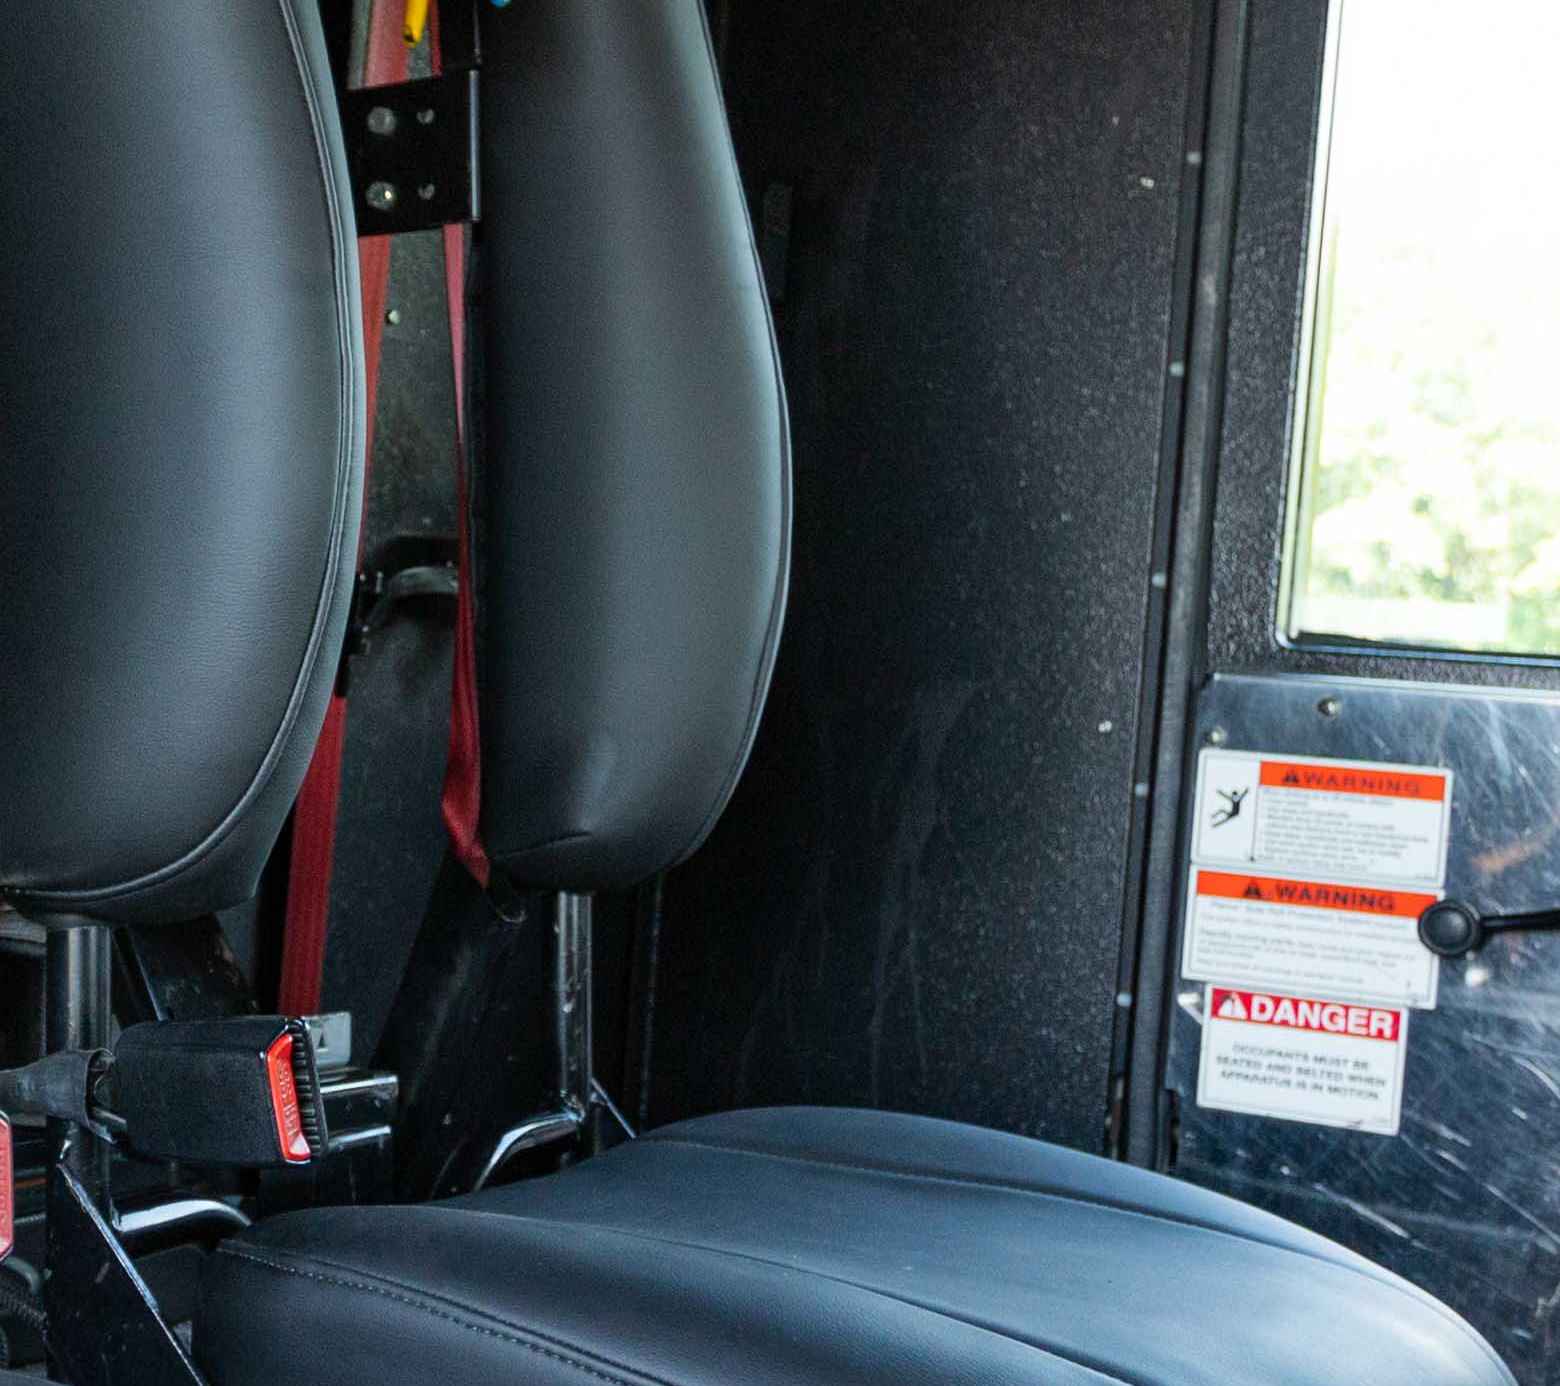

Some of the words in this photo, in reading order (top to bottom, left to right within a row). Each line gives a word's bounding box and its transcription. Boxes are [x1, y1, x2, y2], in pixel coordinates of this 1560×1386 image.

[1303, 773, 1420, 795] WARNING
[1275, 883, 1396, 911] WARNING
[1249, 994, 1394, 1039] DANGER
[1232, 1043, 1309, 1063] OCCUPANTS
[1313, 1054, 1349, 1070] MUST
